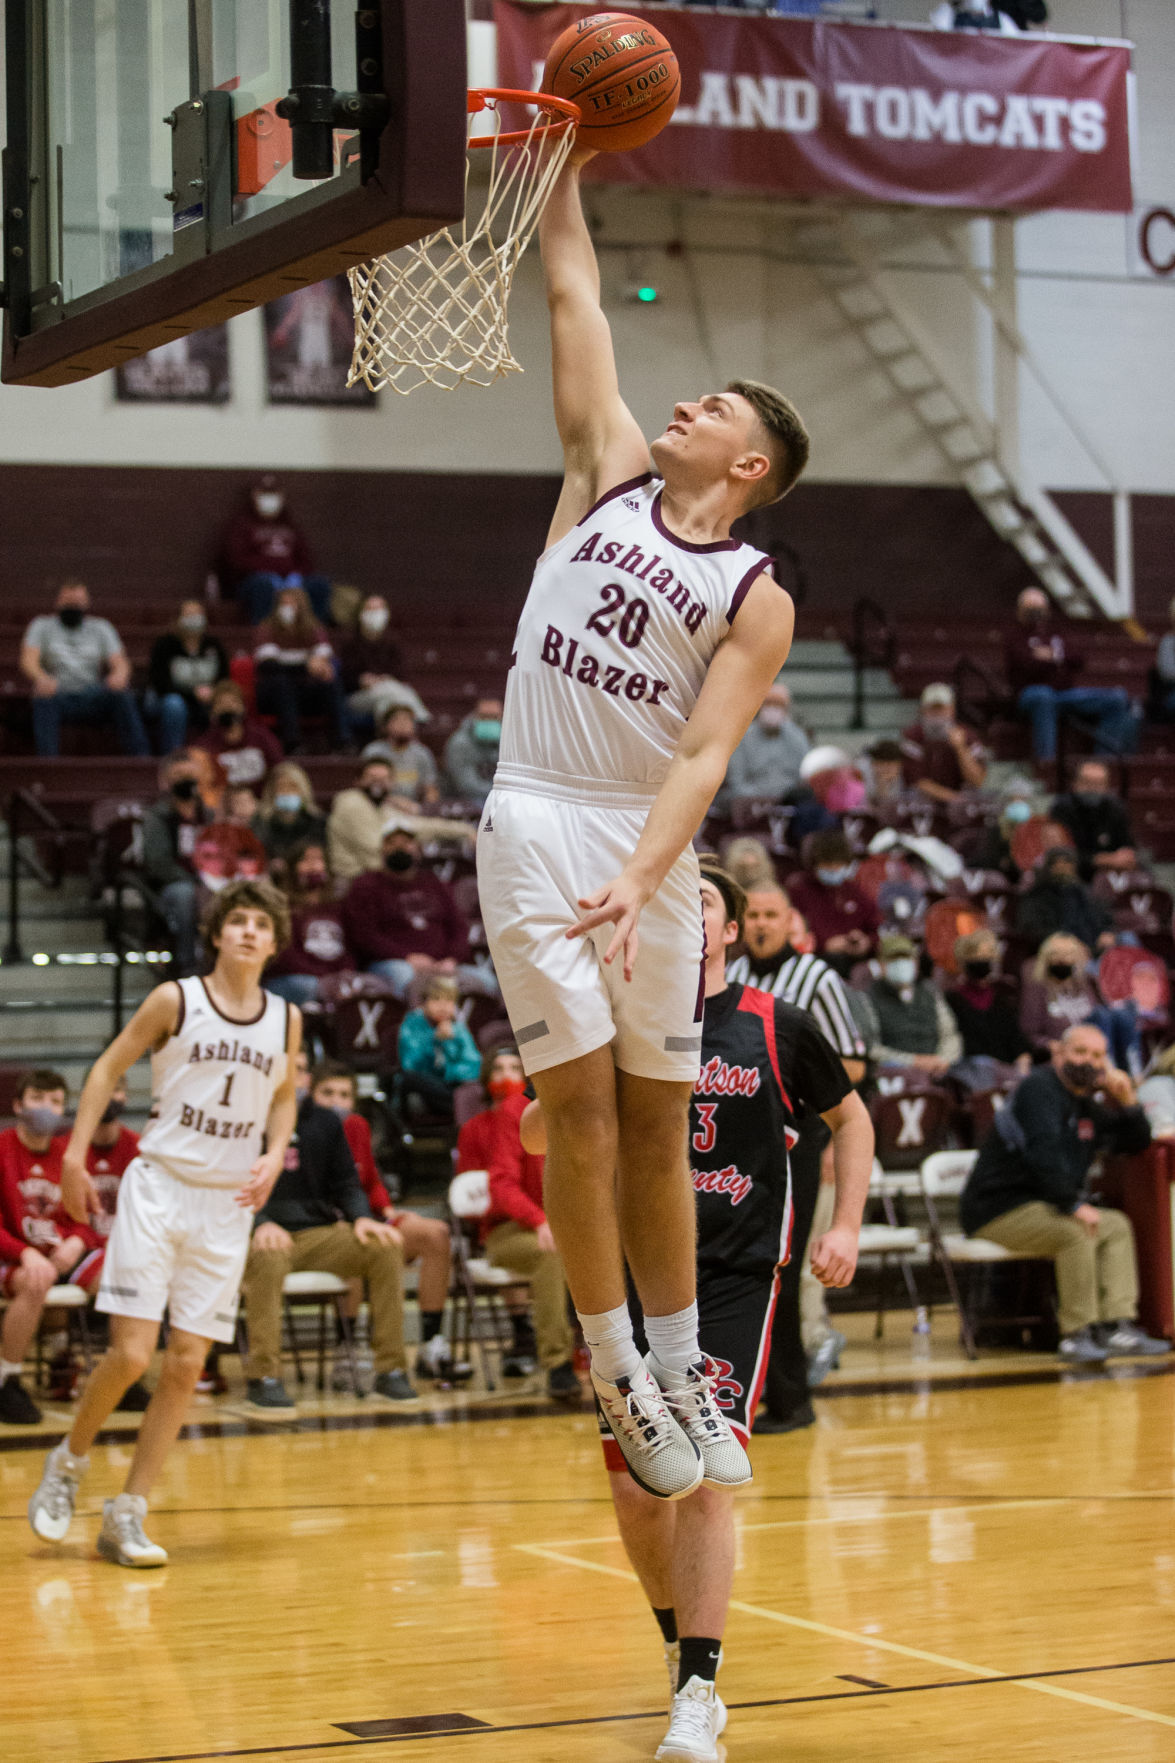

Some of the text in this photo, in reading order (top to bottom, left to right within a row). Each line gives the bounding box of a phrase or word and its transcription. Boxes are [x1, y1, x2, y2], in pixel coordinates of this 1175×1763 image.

[569, 29, 656, 83] SPALDING
[834, 81, 1107, 153] TOMCATS
[569, 532, 707, 637] Ashland
[585, 583, 650, 648] 20
[540, 623, 670, 706] Blazer
[188, 1039, 274, 1078] Ashland
[218, 1071, 236, 1107] 1
[180, 1102, 255, 1139] Blazer
[693, 1102, 718, 1152] 3
